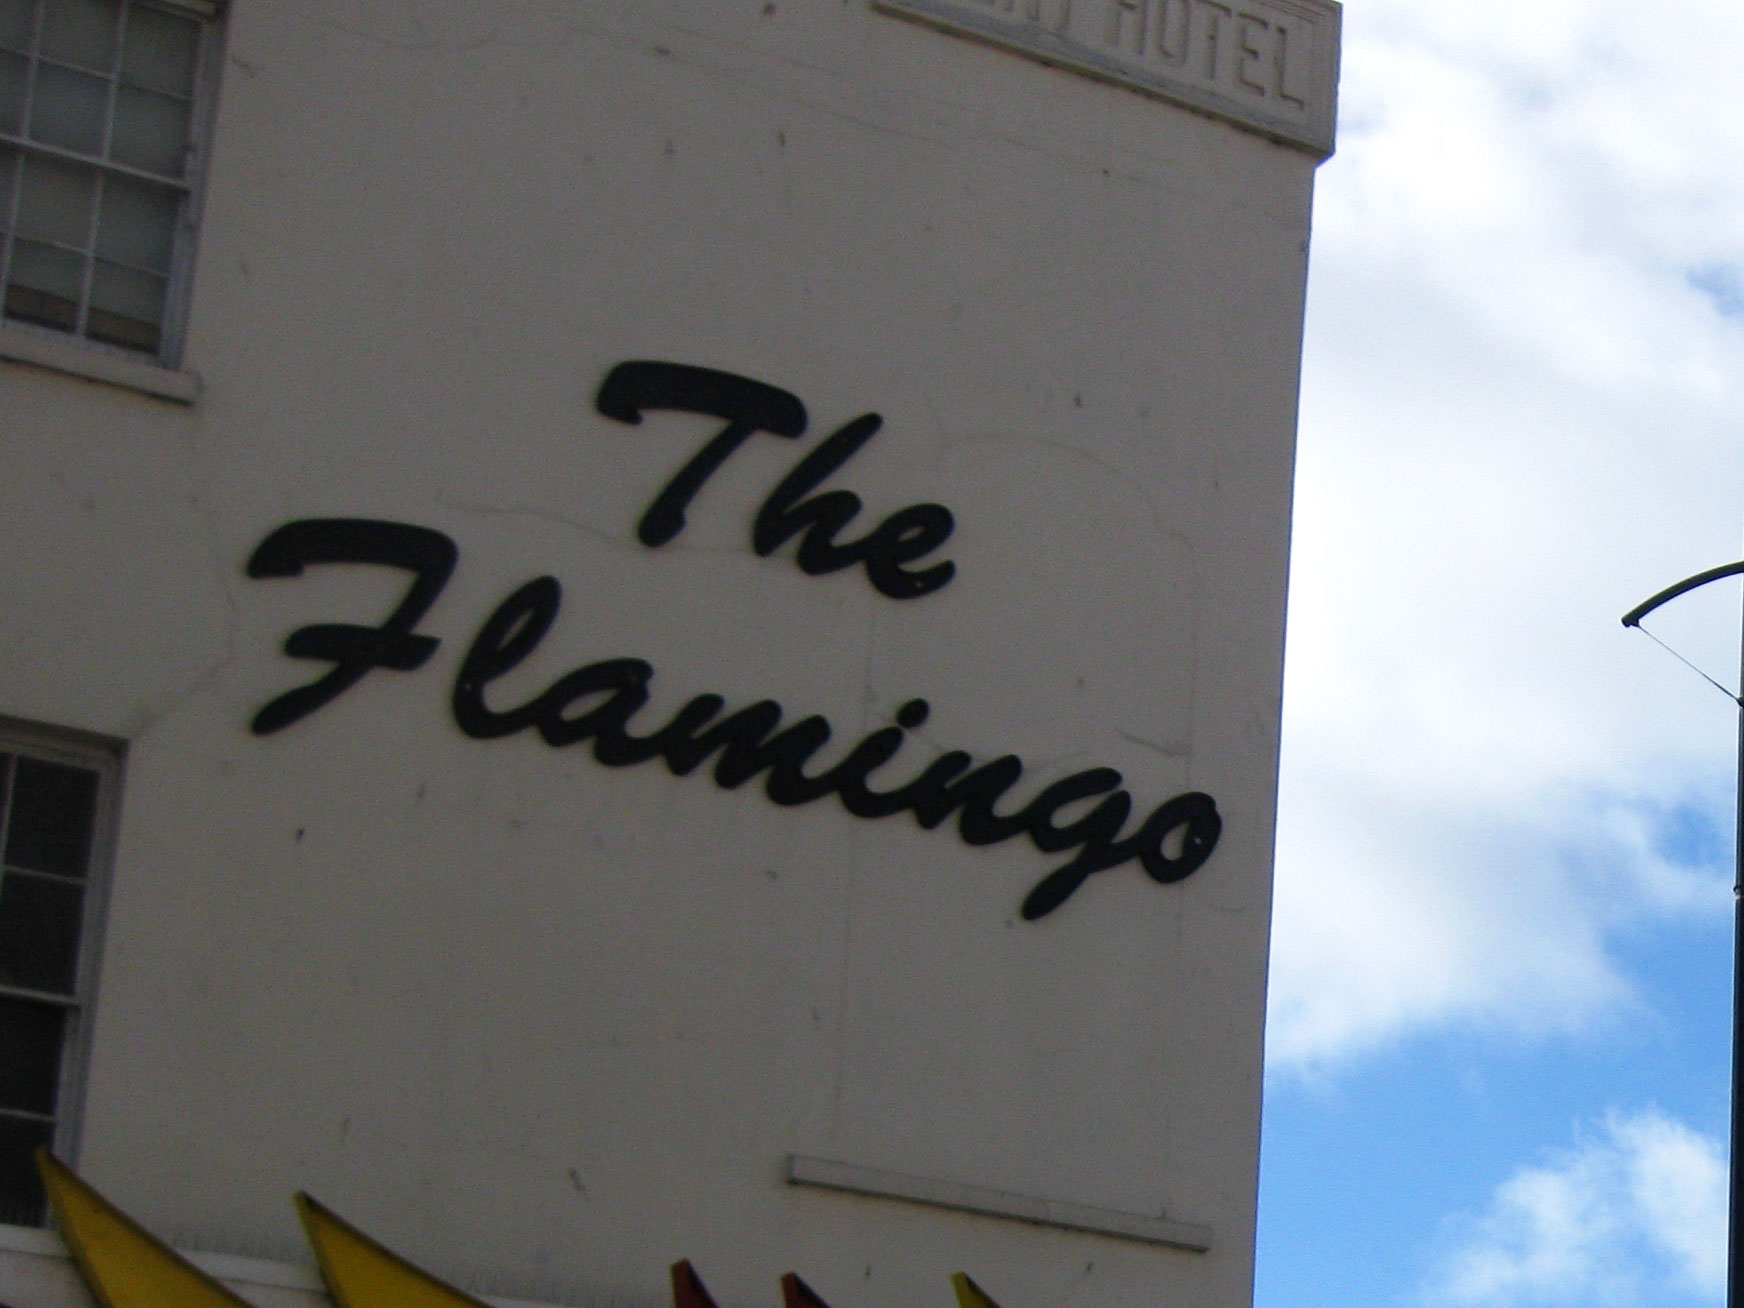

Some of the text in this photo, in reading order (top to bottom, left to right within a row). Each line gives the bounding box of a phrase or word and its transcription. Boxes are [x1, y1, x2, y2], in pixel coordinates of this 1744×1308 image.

[1100, 0, 1305, 110] HOTEL
[595, 359, 956, 600] The
[246, 517, 1223, 921] Flamingo
